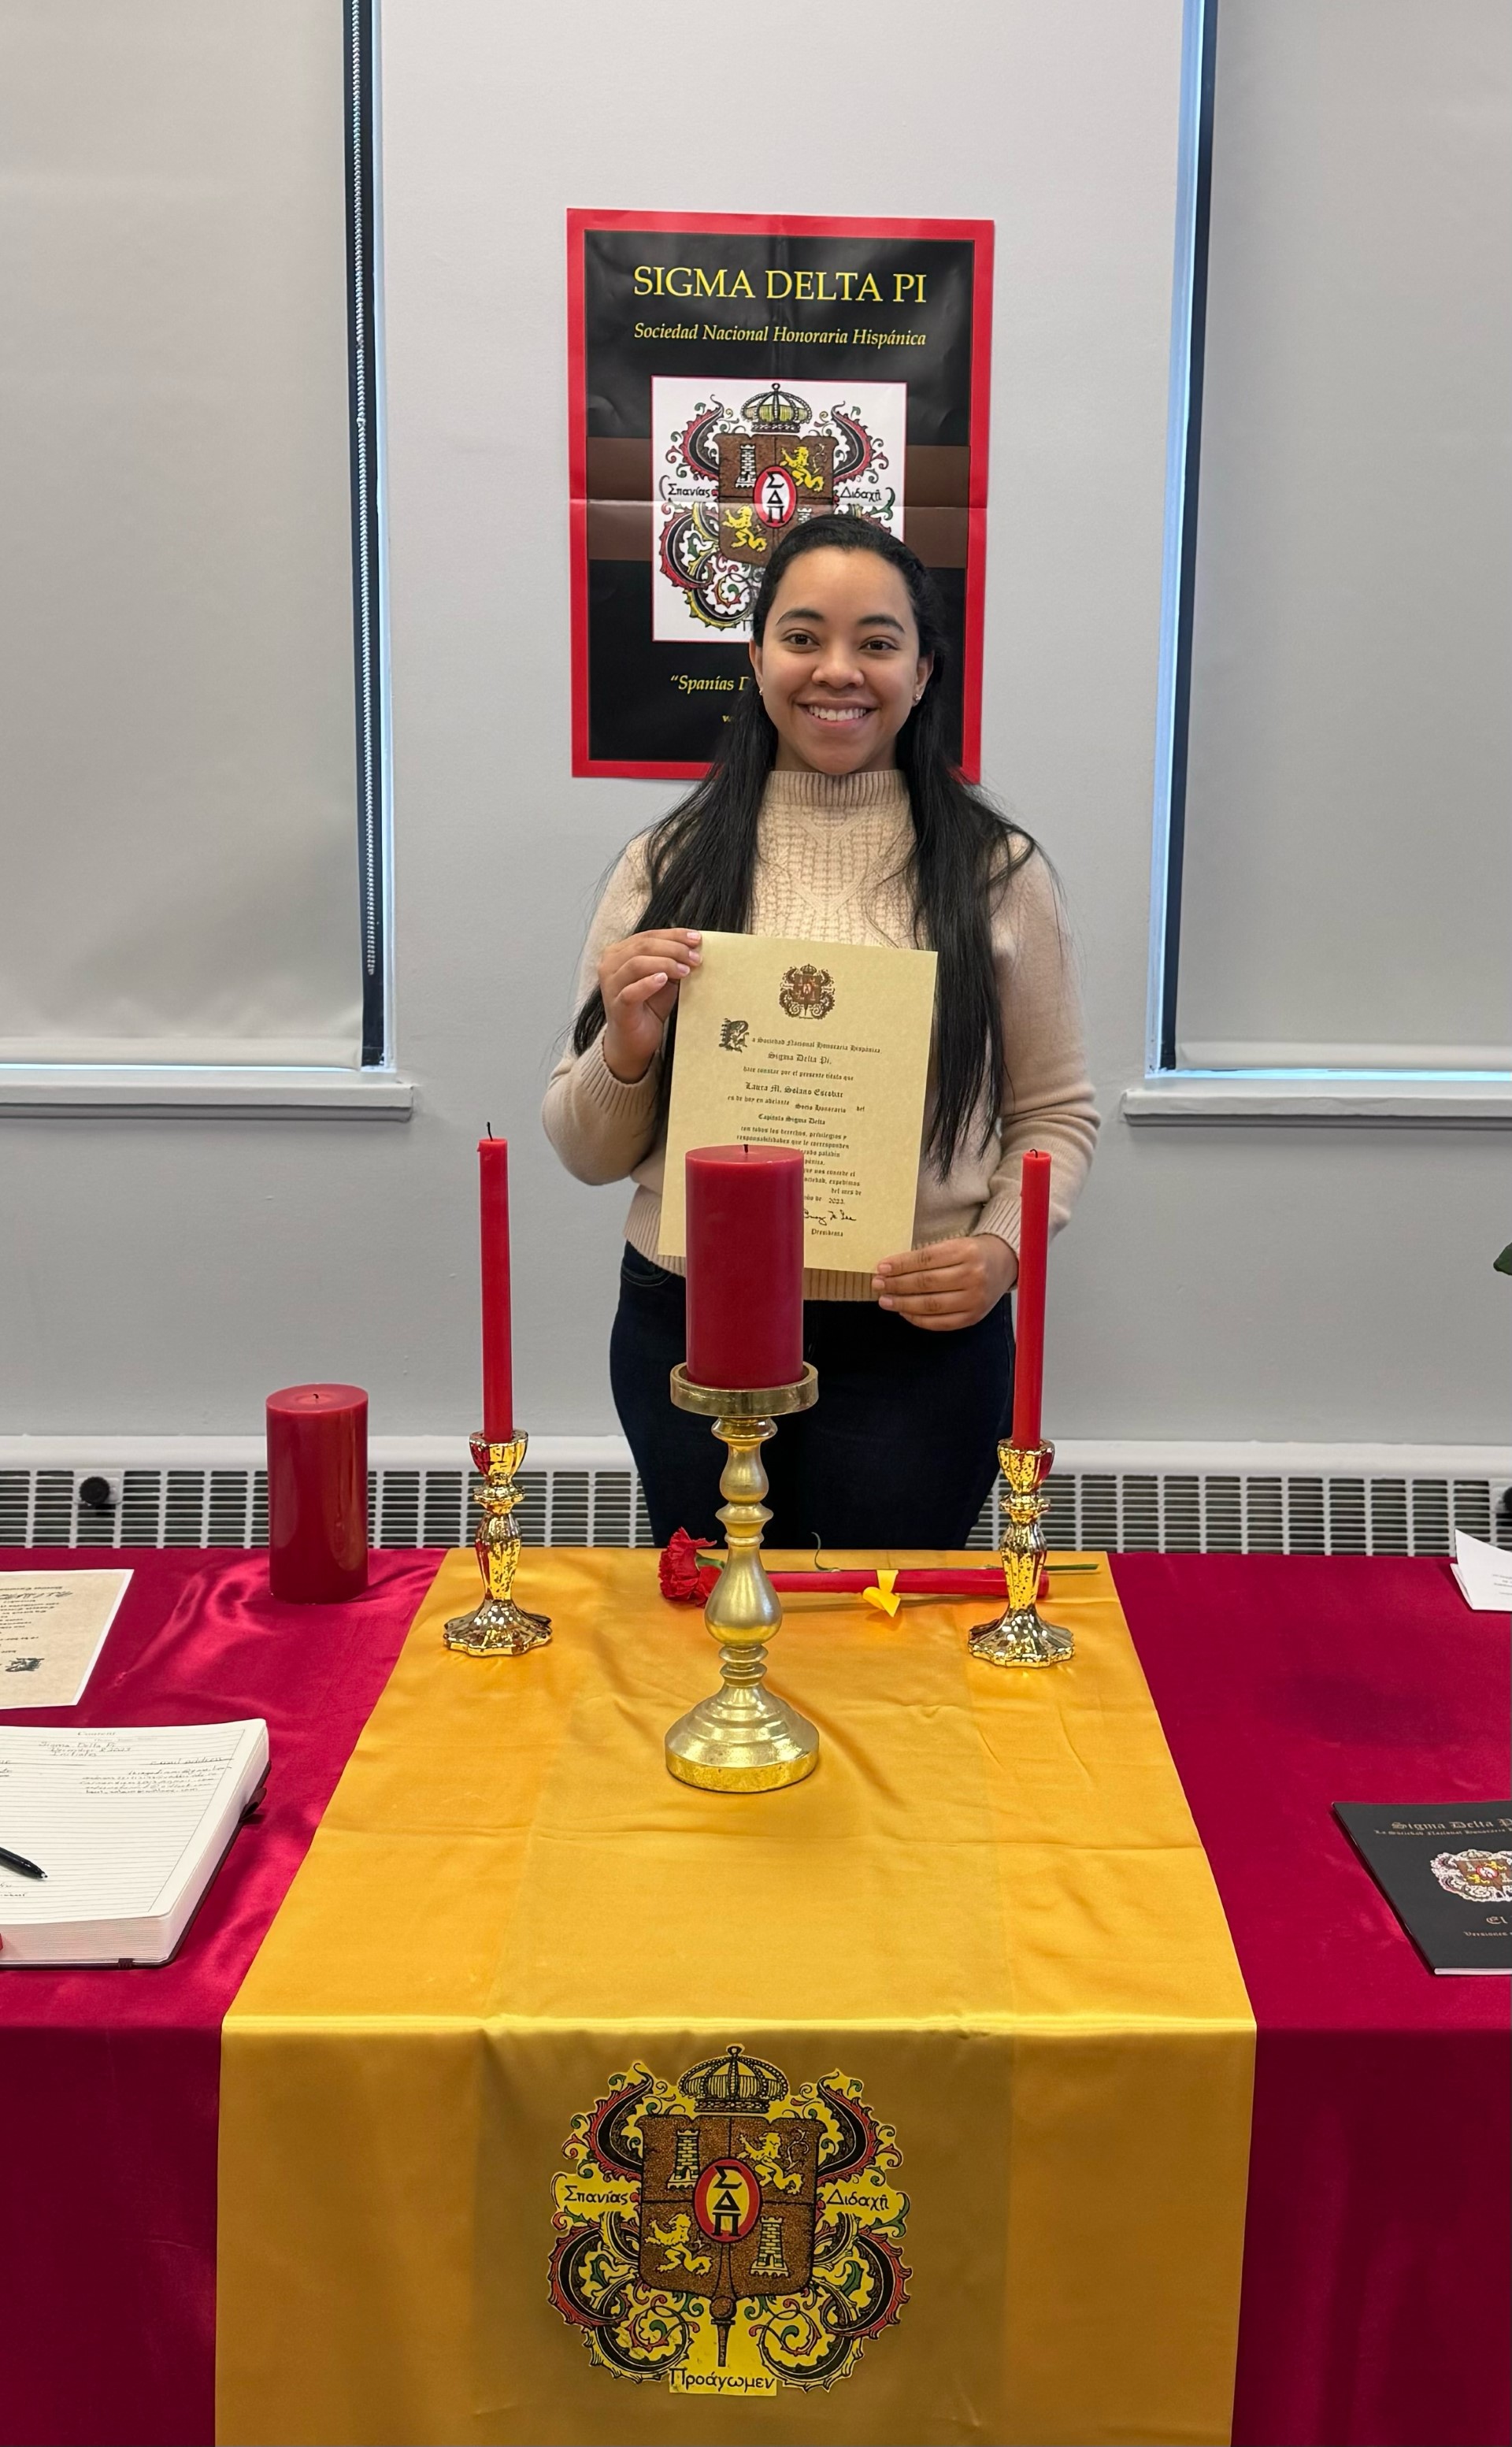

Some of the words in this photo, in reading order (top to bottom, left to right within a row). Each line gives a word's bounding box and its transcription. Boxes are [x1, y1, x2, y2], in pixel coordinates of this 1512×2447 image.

[634, 265, 756, 298] SIGMA
[765, 270, 884, 302] DELTA
[892, 273, 927, 302] PI
[634, 322, 699, 339] Sociedad
[702, 324, 769, 341] Nacional
[773, 326, 848, 343] Honoraria
[852, 328, 927, 350] Hispánica
[768, 1051, 794, 1061] Sigma
[796, 1054, 817, 1062] Delta
[1391, 1821, 1446, 1831] Sigma
[1448, 1820, 1494, 1829] Delta
